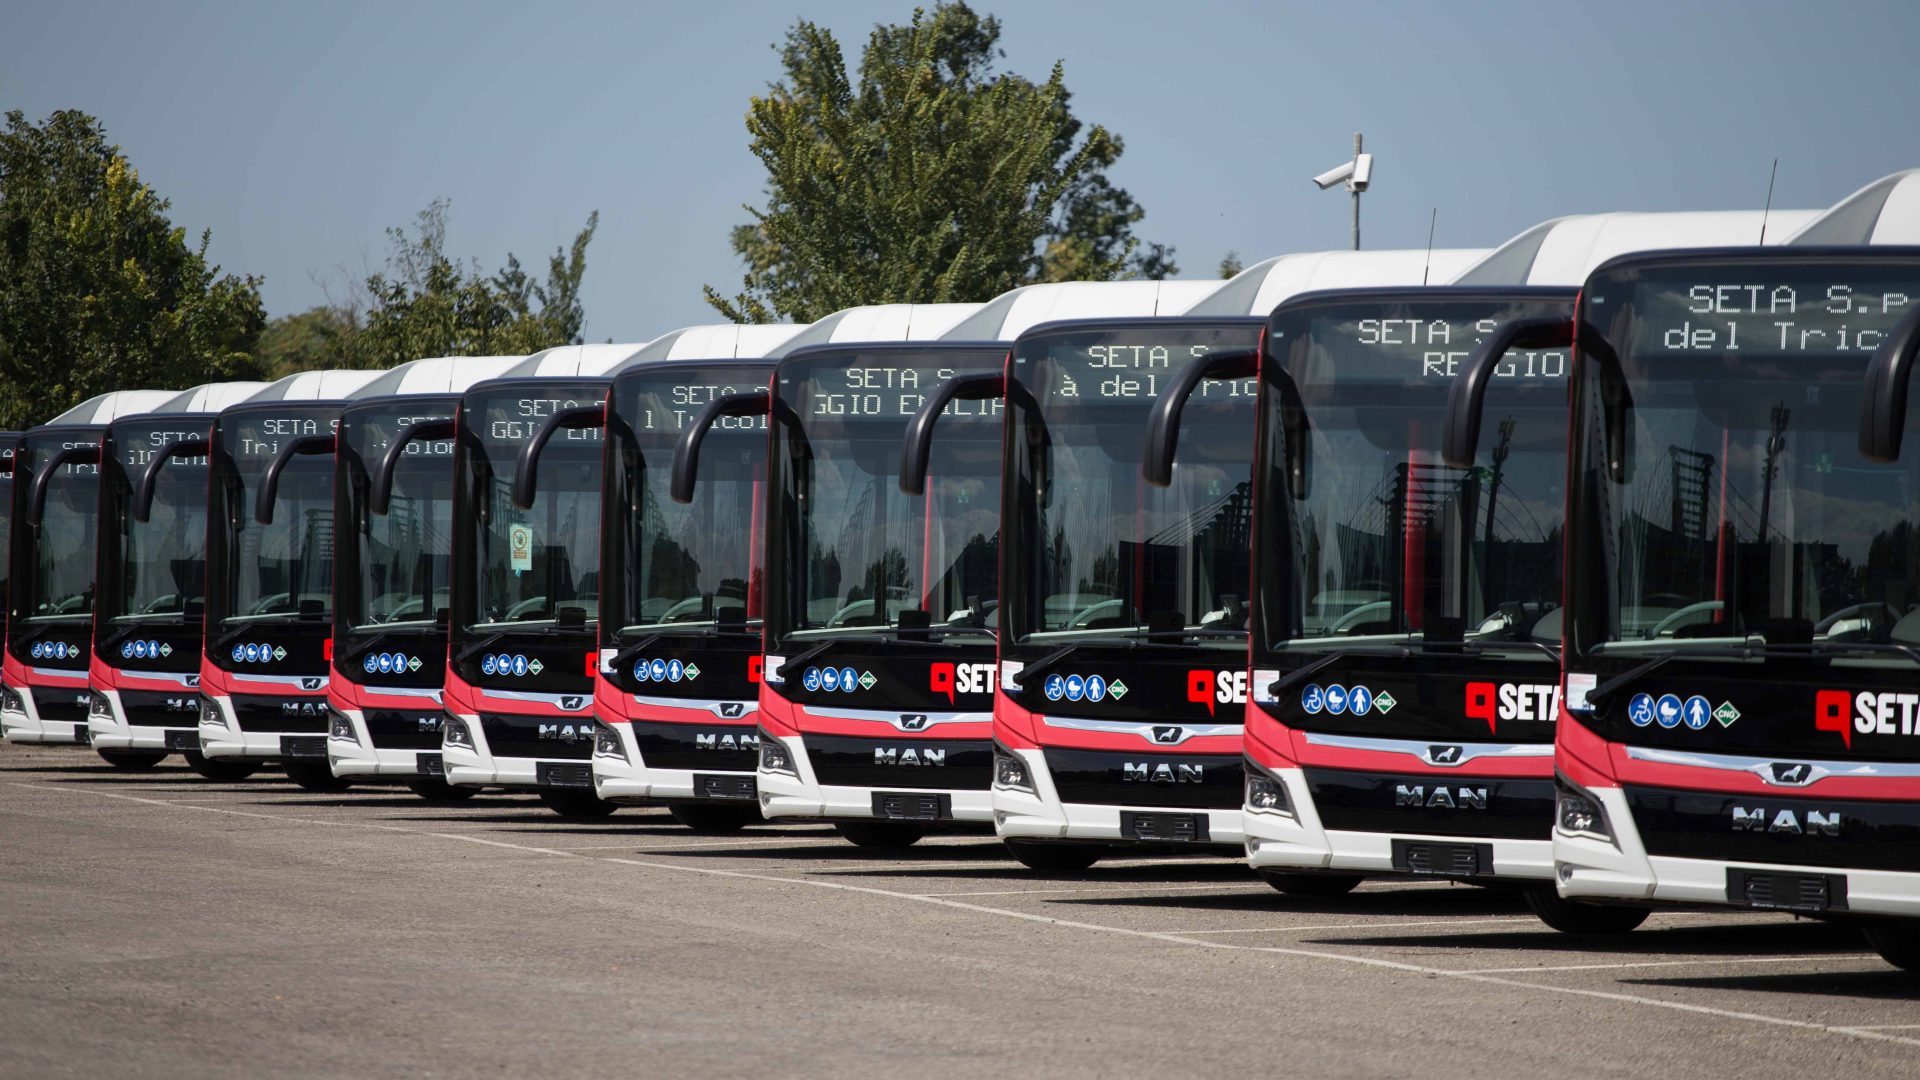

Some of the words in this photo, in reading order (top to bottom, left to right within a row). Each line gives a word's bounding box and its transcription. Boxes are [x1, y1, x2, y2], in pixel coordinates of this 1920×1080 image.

[1689, 285, 1796, 314] SETA
[1358, 319, 1450, 344] SETA
[1664, 321, 1739, 350] del
[1088, 345, 1168, 368] SETA
[1423, 352, 1564, 377] REGIO
[846, 368, 918, 388] SETA
[1100, 374, 1157, 396] del
[263, 419, 317, 435] SETA
[1111, 685, 1124, 693] CNG
[1377, 698, 1392, 707] CNG
[1854, 691, 1920, 736] SET
[1718, 709, 1735, 719] CNG
[695, 733, 759, 751] MAN
[874, 747, 946, 767] MAN
[1123, 762, 1203, 784] MAN
[1396, 784, 1488, 810] MAN
[1732, 805, 1841, 837] MAN
